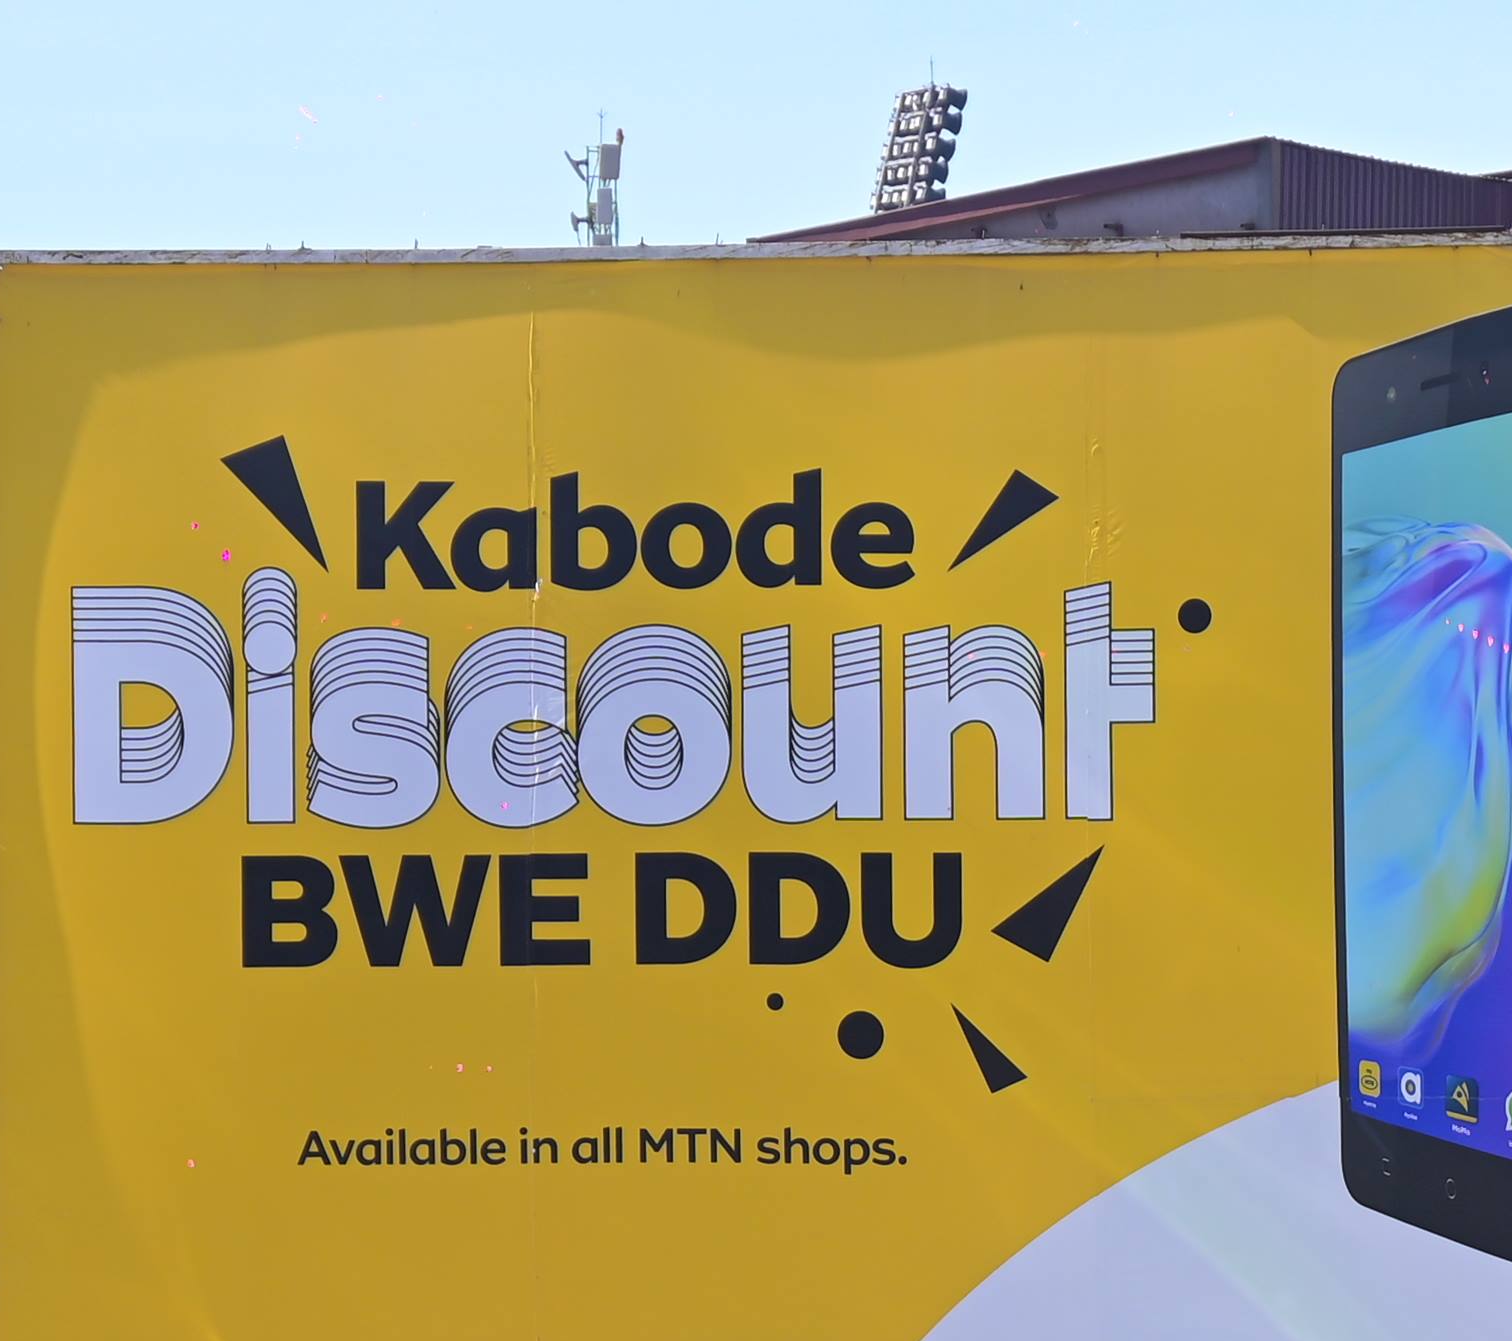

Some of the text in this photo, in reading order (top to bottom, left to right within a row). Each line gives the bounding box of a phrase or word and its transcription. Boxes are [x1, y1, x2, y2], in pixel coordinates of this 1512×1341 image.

[356, 468, 915, 591] Kabode
[71, 567, 1155, 828] Discount
[242, 853, 963, 967] BWE DDU
[297, 1126, 908, 1175] Available in all MTN shops.
